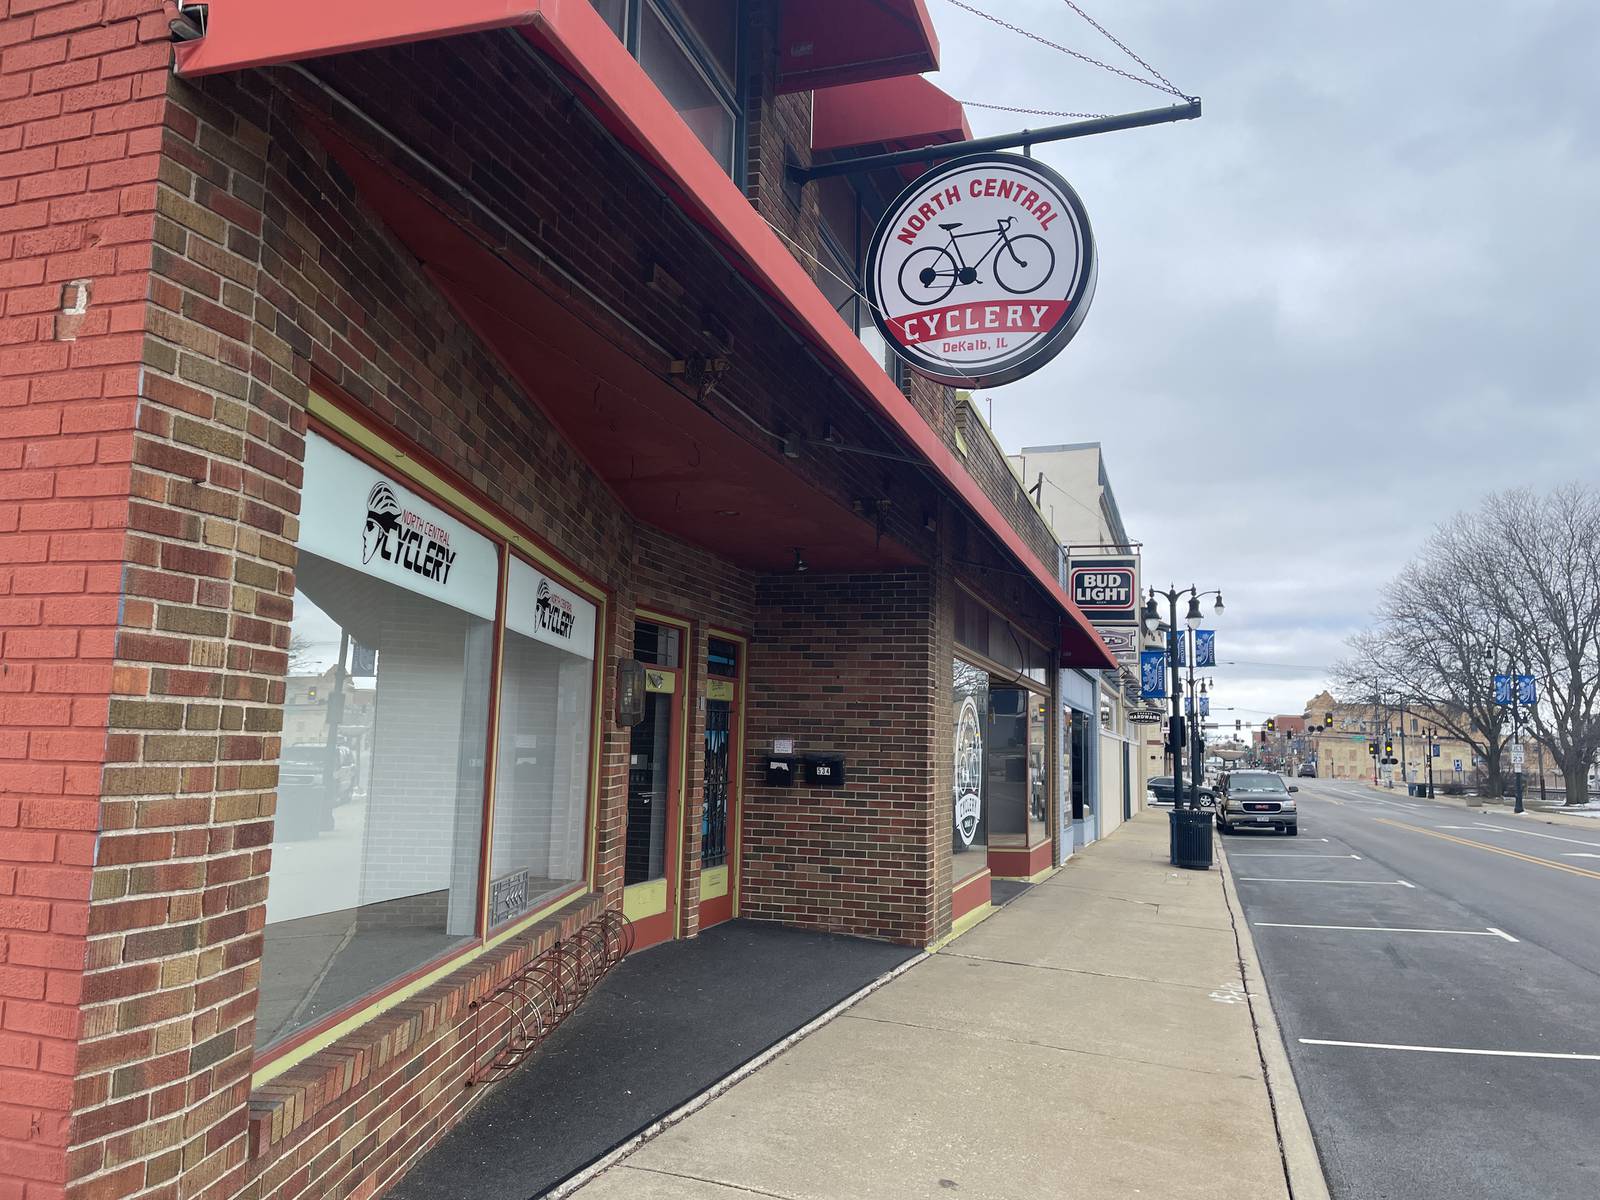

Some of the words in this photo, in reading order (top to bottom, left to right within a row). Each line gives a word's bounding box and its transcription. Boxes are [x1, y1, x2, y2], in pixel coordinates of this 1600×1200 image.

[897, 184, 961, 246] NORTH
[969, 178, 1059, 232] CENTRAL
[904, 305, 1049, 341] CYCLERY
[943, 340, 991, 353] DeKalb,
[996, 337, 1008, 348] IL
[402, 509, 425, 532] NORTH
[424, 521, 450, 547] CENTRAL
[381, 521, 456, 585] CYCLERY
[1076, 587, 1129, 601] LIGHT
[1083, 574, 1122, 588] BUD
[541, 604, 576, 639] CYCLERY
